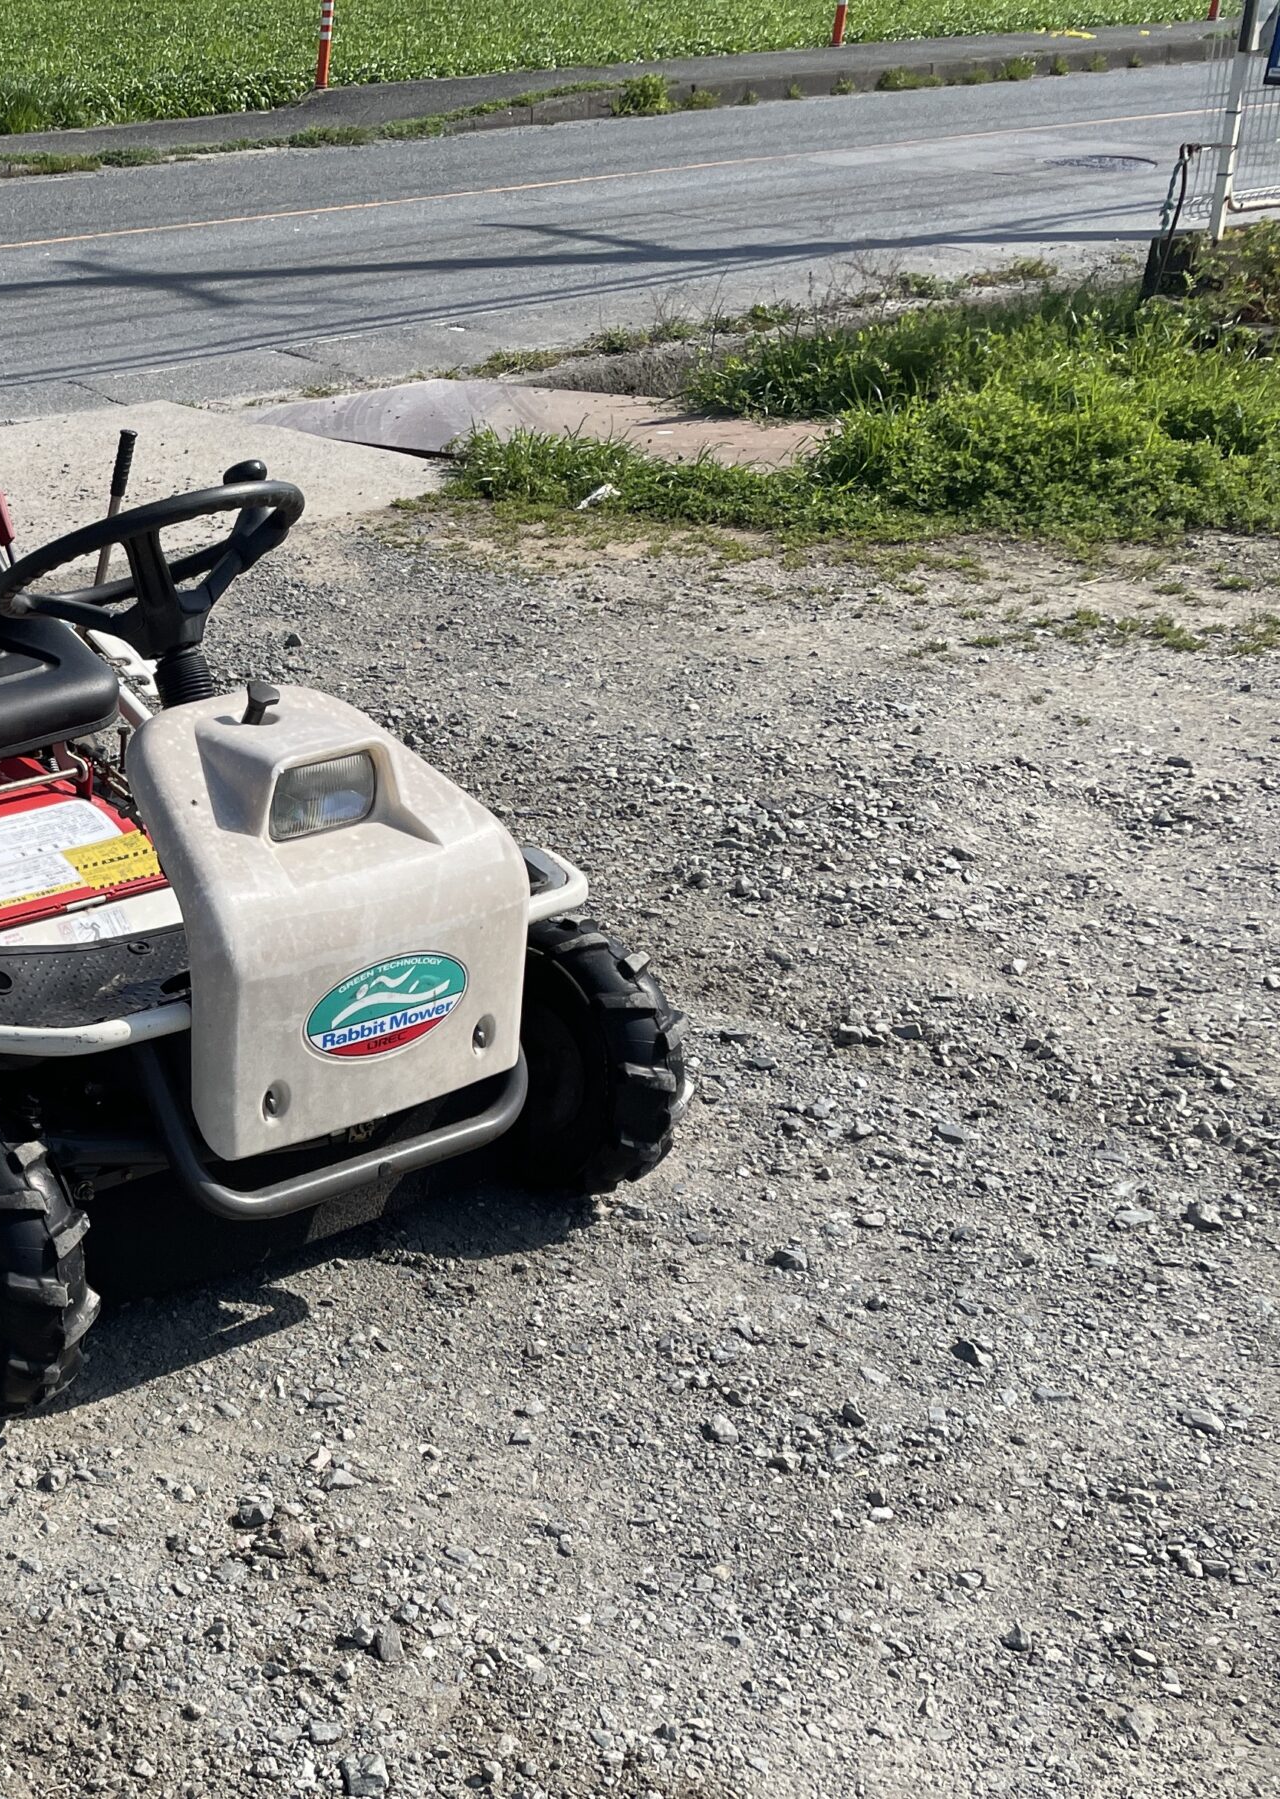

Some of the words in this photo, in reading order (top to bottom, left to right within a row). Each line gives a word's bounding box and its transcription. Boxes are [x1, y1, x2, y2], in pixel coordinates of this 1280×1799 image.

[338, 970, 374, 993] GREEN
[376, 957, 443, 973] TECHNOLOGY
[322, 1020, 386, 1048] Rabbit
[389, 1000, 453, 1030] Mower
